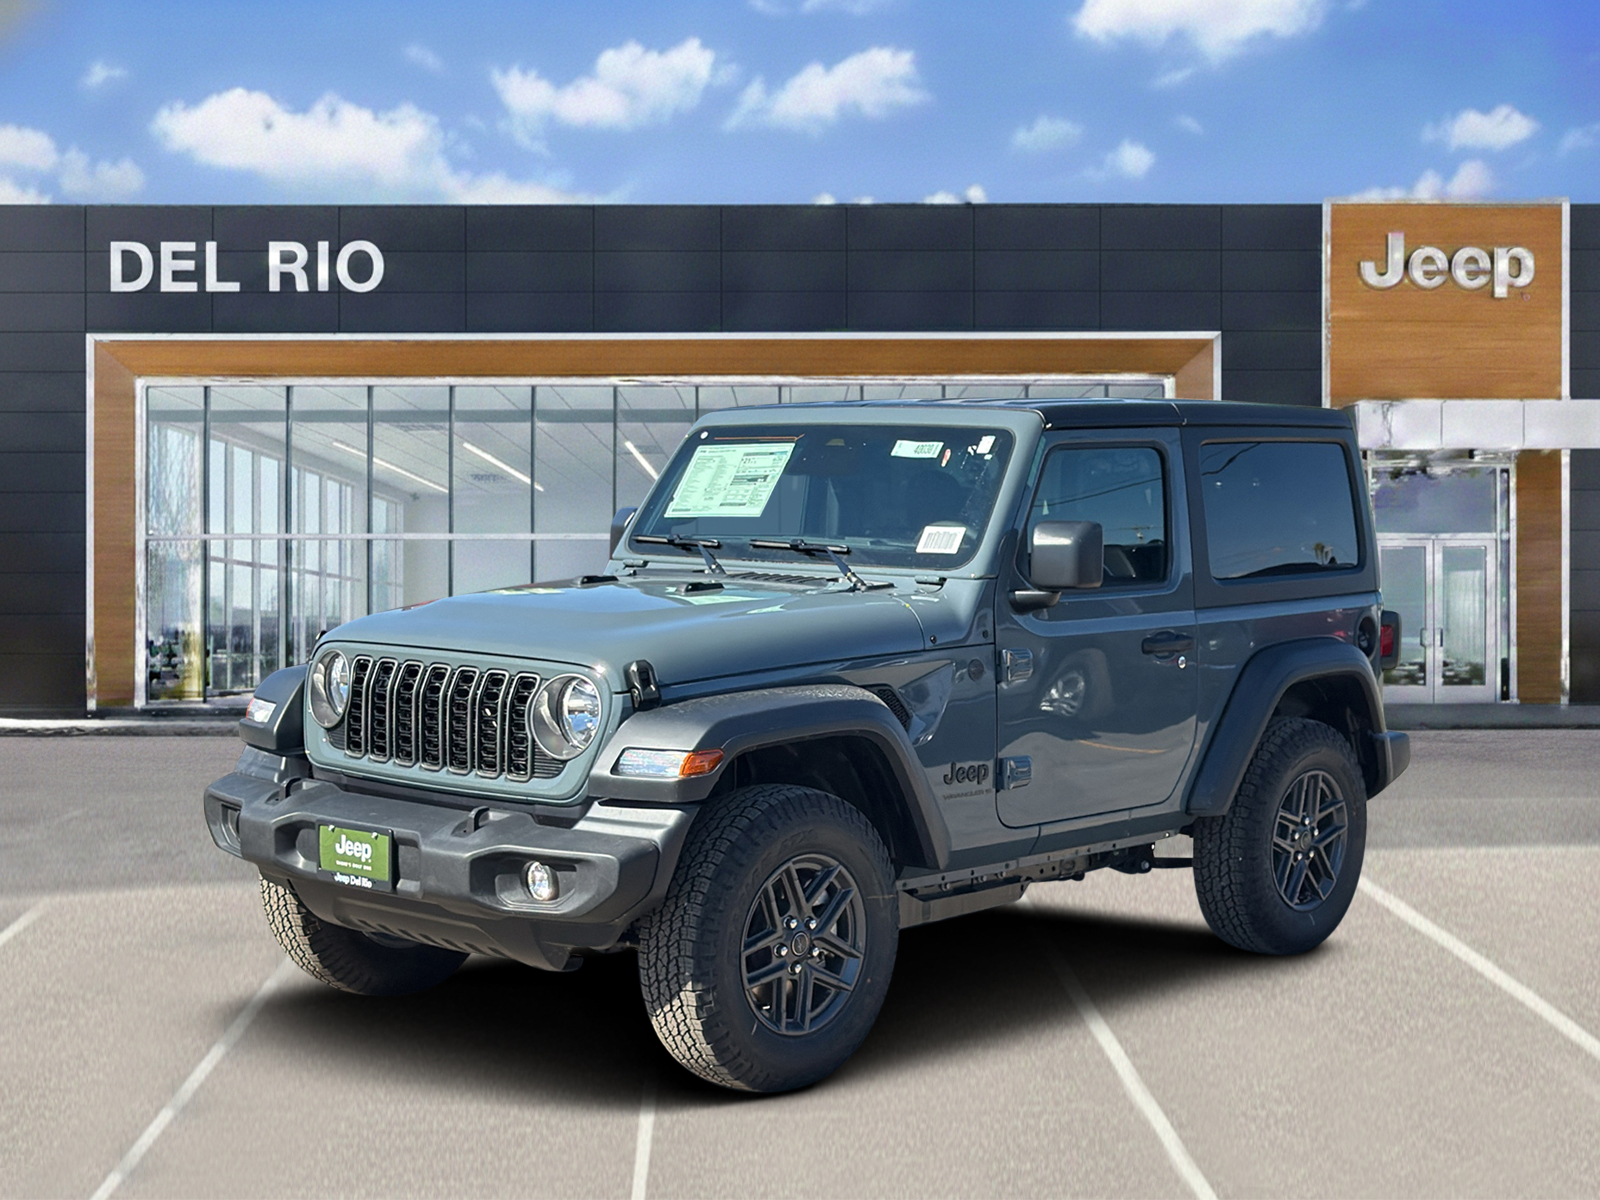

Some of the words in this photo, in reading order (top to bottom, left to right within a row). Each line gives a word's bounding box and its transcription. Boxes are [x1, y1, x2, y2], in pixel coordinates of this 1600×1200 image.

[110, 241, 240, 292] DEL
[268, 240, 385, 293] RIO
[1359, 231, 1536, 299] Jeep
[943, 761, 989, 784] Jeep
[335, 834, 372, 862] Jeep
[334, 872, 350, 884] Jeep
